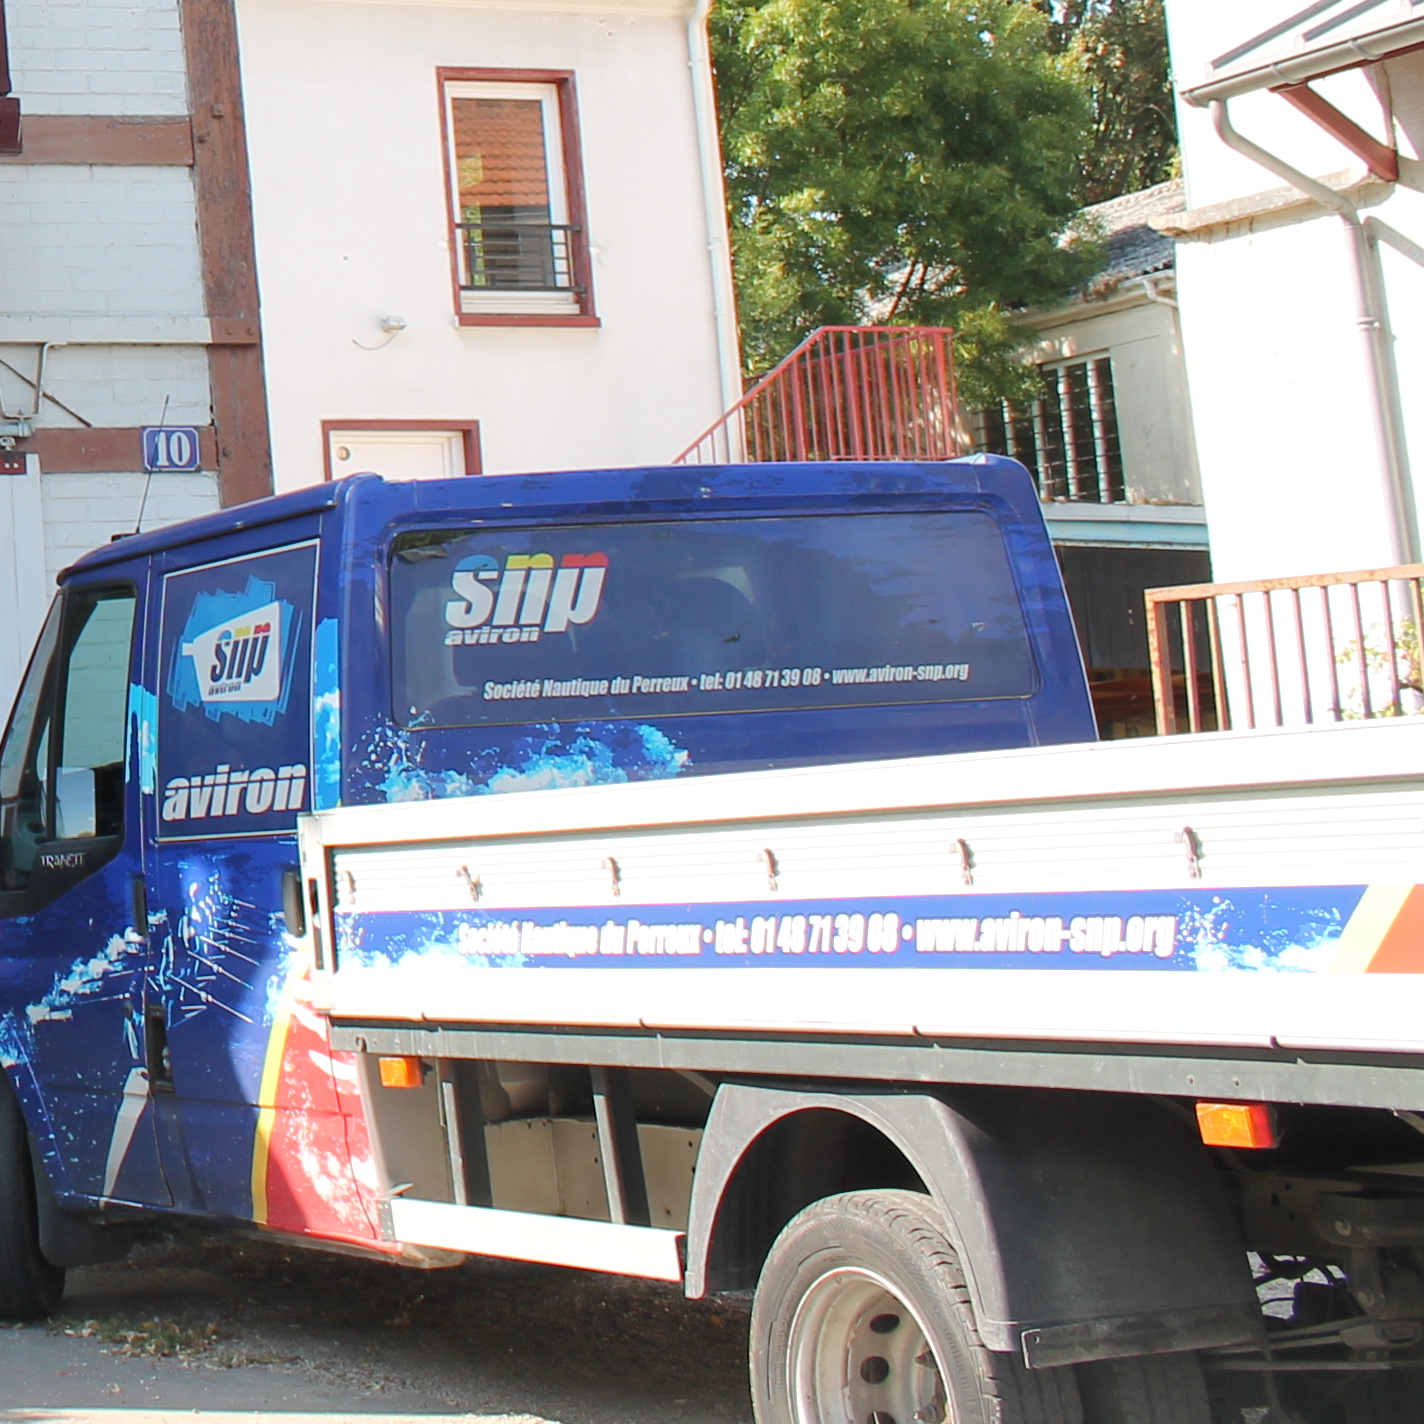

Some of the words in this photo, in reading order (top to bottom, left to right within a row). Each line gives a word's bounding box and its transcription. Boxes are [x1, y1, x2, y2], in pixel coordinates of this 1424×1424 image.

[155, 431, 191, 466] 10
[445, 552, 609, 633] snp
[210, 621, 271, 683] snp
[444, 626, 540, 646] aviron
[207, 681, 242, 695] aviron
[483, 679, 541, 700] Société
[542, 677, 608, 698] Nautique
[610, 676, 630, 694] du
[632, 674, 689, 693] Perreux
[699, 671, 723, 690] tel:
[725, 670, 742, 689] 01
[743, 669, 762, 688] 48
[764, 669, 778, 688] 71
[781, 668, 799, 687] 39
[802, 667, 821, 686] 08
[832, 663, 970, 685] www.aviron-snp.org
[162, 763, 307, 821] aviron
[600, 919, 625, 955] du
[626, 919, 702, 955] Perreux
[714, 917, 748, 954] tel:
[751, 916, 776, 954] 01
[777, 915, 805, 954] 48
[808, 914, 833, 953] 71
[834, 913, 864, 953] 39
[867, 912, 899, 953] 08
[916, 910, 1177, 958] www.aviron-snp.org
